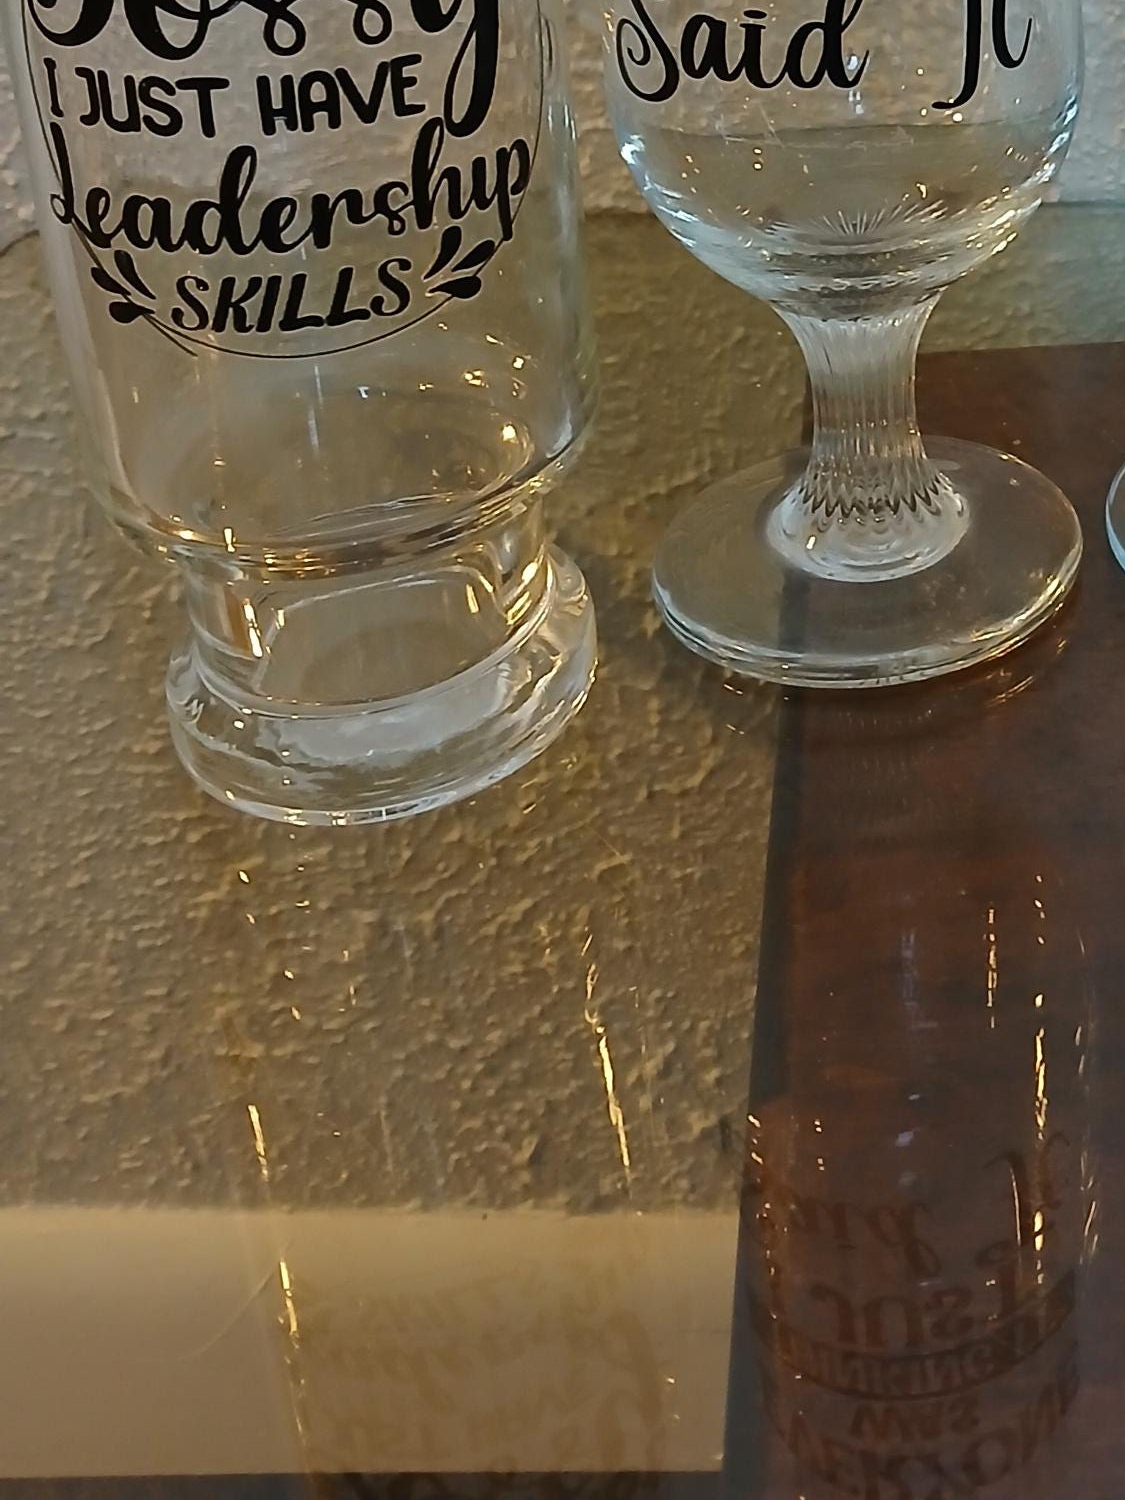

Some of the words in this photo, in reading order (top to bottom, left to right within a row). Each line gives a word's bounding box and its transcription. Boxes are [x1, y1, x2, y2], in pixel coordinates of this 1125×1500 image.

[43, 57, 64, 120] I
[74, 65, 230, 138] JUST
[257, 53, 427, 136] HAVE
[171, 258, 412, 335] SKILLS
